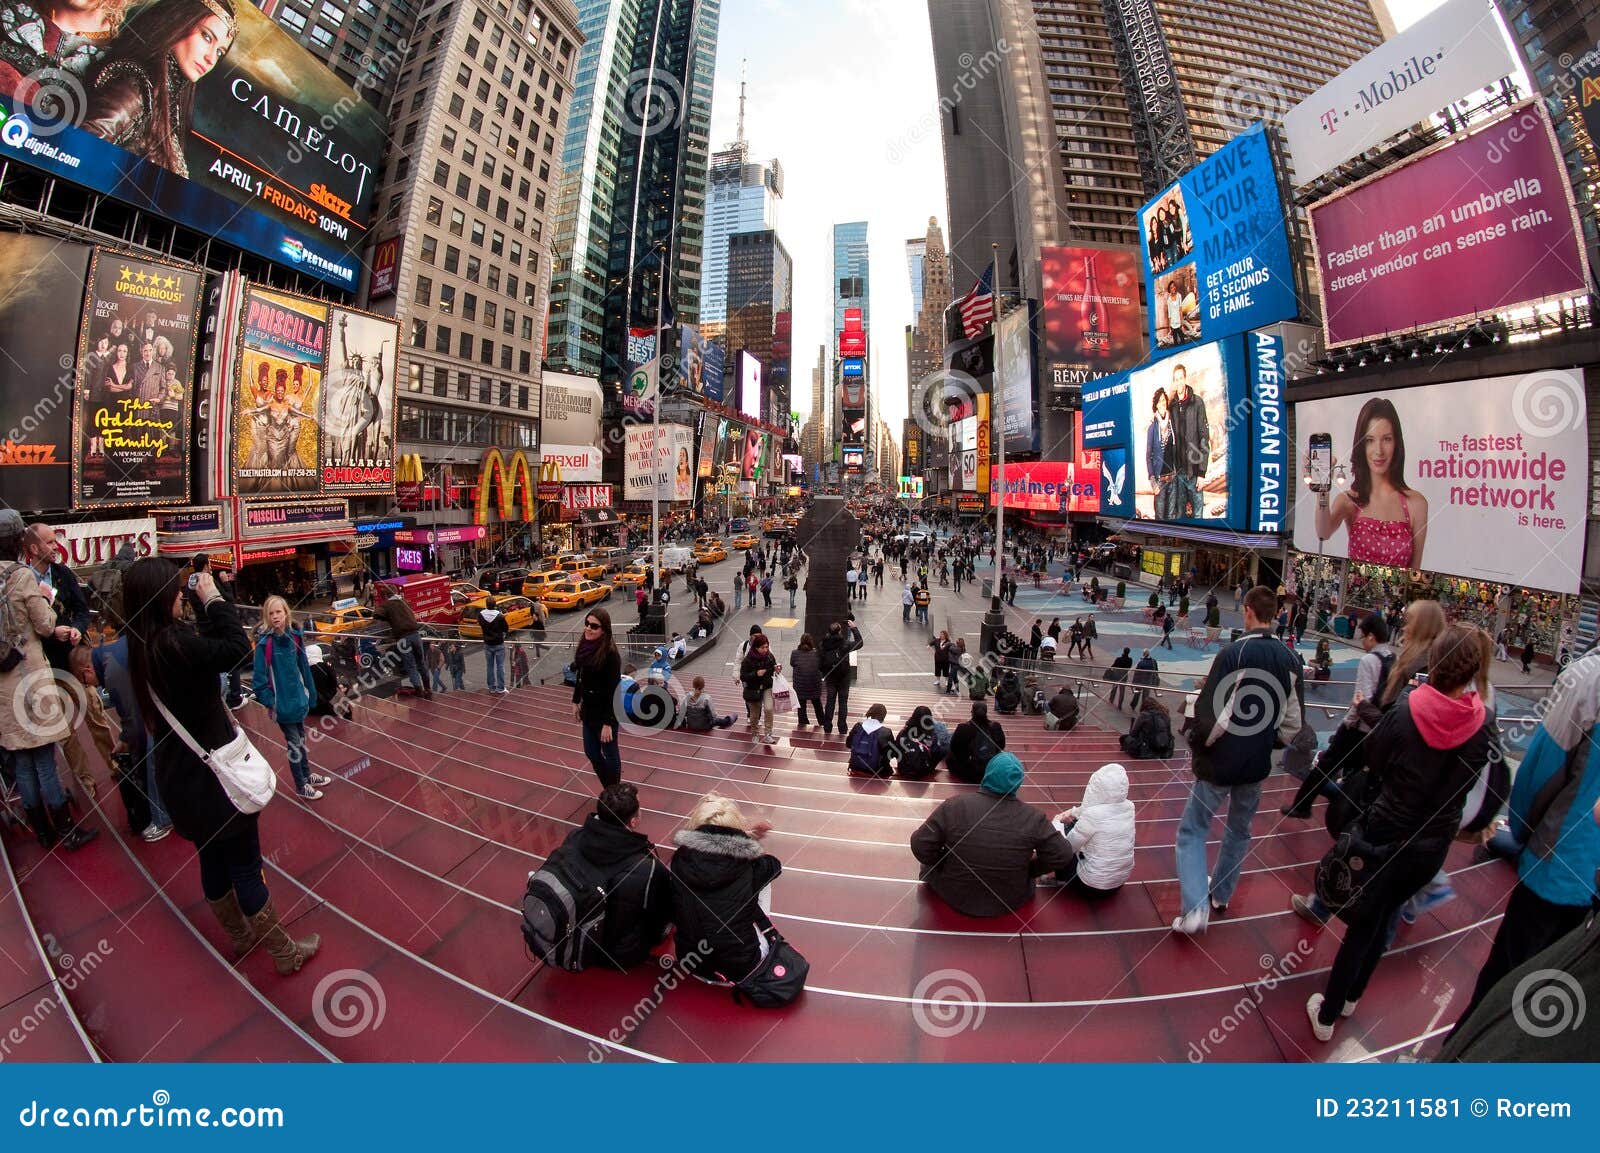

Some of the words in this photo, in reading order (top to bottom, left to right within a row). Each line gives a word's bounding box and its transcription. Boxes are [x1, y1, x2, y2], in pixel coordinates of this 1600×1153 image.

[1128, 28, 1160, 113] AMERICAN
[231, 79, 371, 205] CAMELOT
[1192, 138, 1252, 197] LEAVE
[209, 158, 253, 192] APRIL
[256, 182, 262, 195] 1
[263, 186, 318, 224] FRIDAYS
[319, 216, 348, 240] 10PM
[1202, 176, 1259, 226] YOUR
[1327, 240, 1375, 270] Faster
[1378, 223, 1418, 250] than
[1422, 213, 1446, 235] an
[1451, 177, 1542, 223] umbrella
[1203, 214, 1268, 266] MARK
[1330, 267, 1368, 292] street
[1370, 250, 1419, 280] vendor
[1423, 240, 1452, 262] can
[1456, 224, 1507, 251] sense
[1512, 207, 1553, 232] rain.
[1206, 271, 1224, 289] GET
[1226, 256, 1254, 281] YOUR
[1208, 287, 1220, 304] 15
[1222, 267, 1270, 301] SECONDS
[1210, 304, 1222, 319] OF
[1224, 294, 1255, 315] FAME.
[247, 300, 324, 351] PRISCILLA
[245, 327, 270, 342] QUEEN
[271, 336, 281, 344] OF
[283, 339, 296, 349] THE
[297, 345, 323, 358] DESERT
[628, 341, 654, 359] BEST
[545, 385, 568, 395] WHERE
[545, 393, 592, 408] MAXIMUM
[1256, 332, 1281, 455] AMERICAN
[95, 407, 174, 429] Addams
[117, 397, 153, 412] The
[545, 402, 592, 415] PERFORMANCE
[545, 411, 568, 421] LIVES
[101, 429, 168, 458] Family
[978, 420, 988, 466] Kodak
[1439, 440, 1459, 452] The
[1462, 433, 1523, 451] fastest
[325, 458, 341, 467] AT
[349, 458, 391, 467] LARGE
[544, 453, 589, 467] maxell
[1418, 451, 1566, 481] nationwide
[323, 467, 392, 483] CHICAGO
[1020, 479, 1096, 496] Amerca
[1259, 462, 1281, 532] EAGLE
[1450, 483, 1555, 510] network
[192, 513, 216, 521] DESERT
[248, 508, 287, 524] PRISCILLA
[286, 507, 303, 515] QUEEN
[305, 506, 313, 514] OF
[324, 505, 343, 513] DESERT
[1518, 512, 1529, 526] is
[1533, 512, 1566, 530] here.
